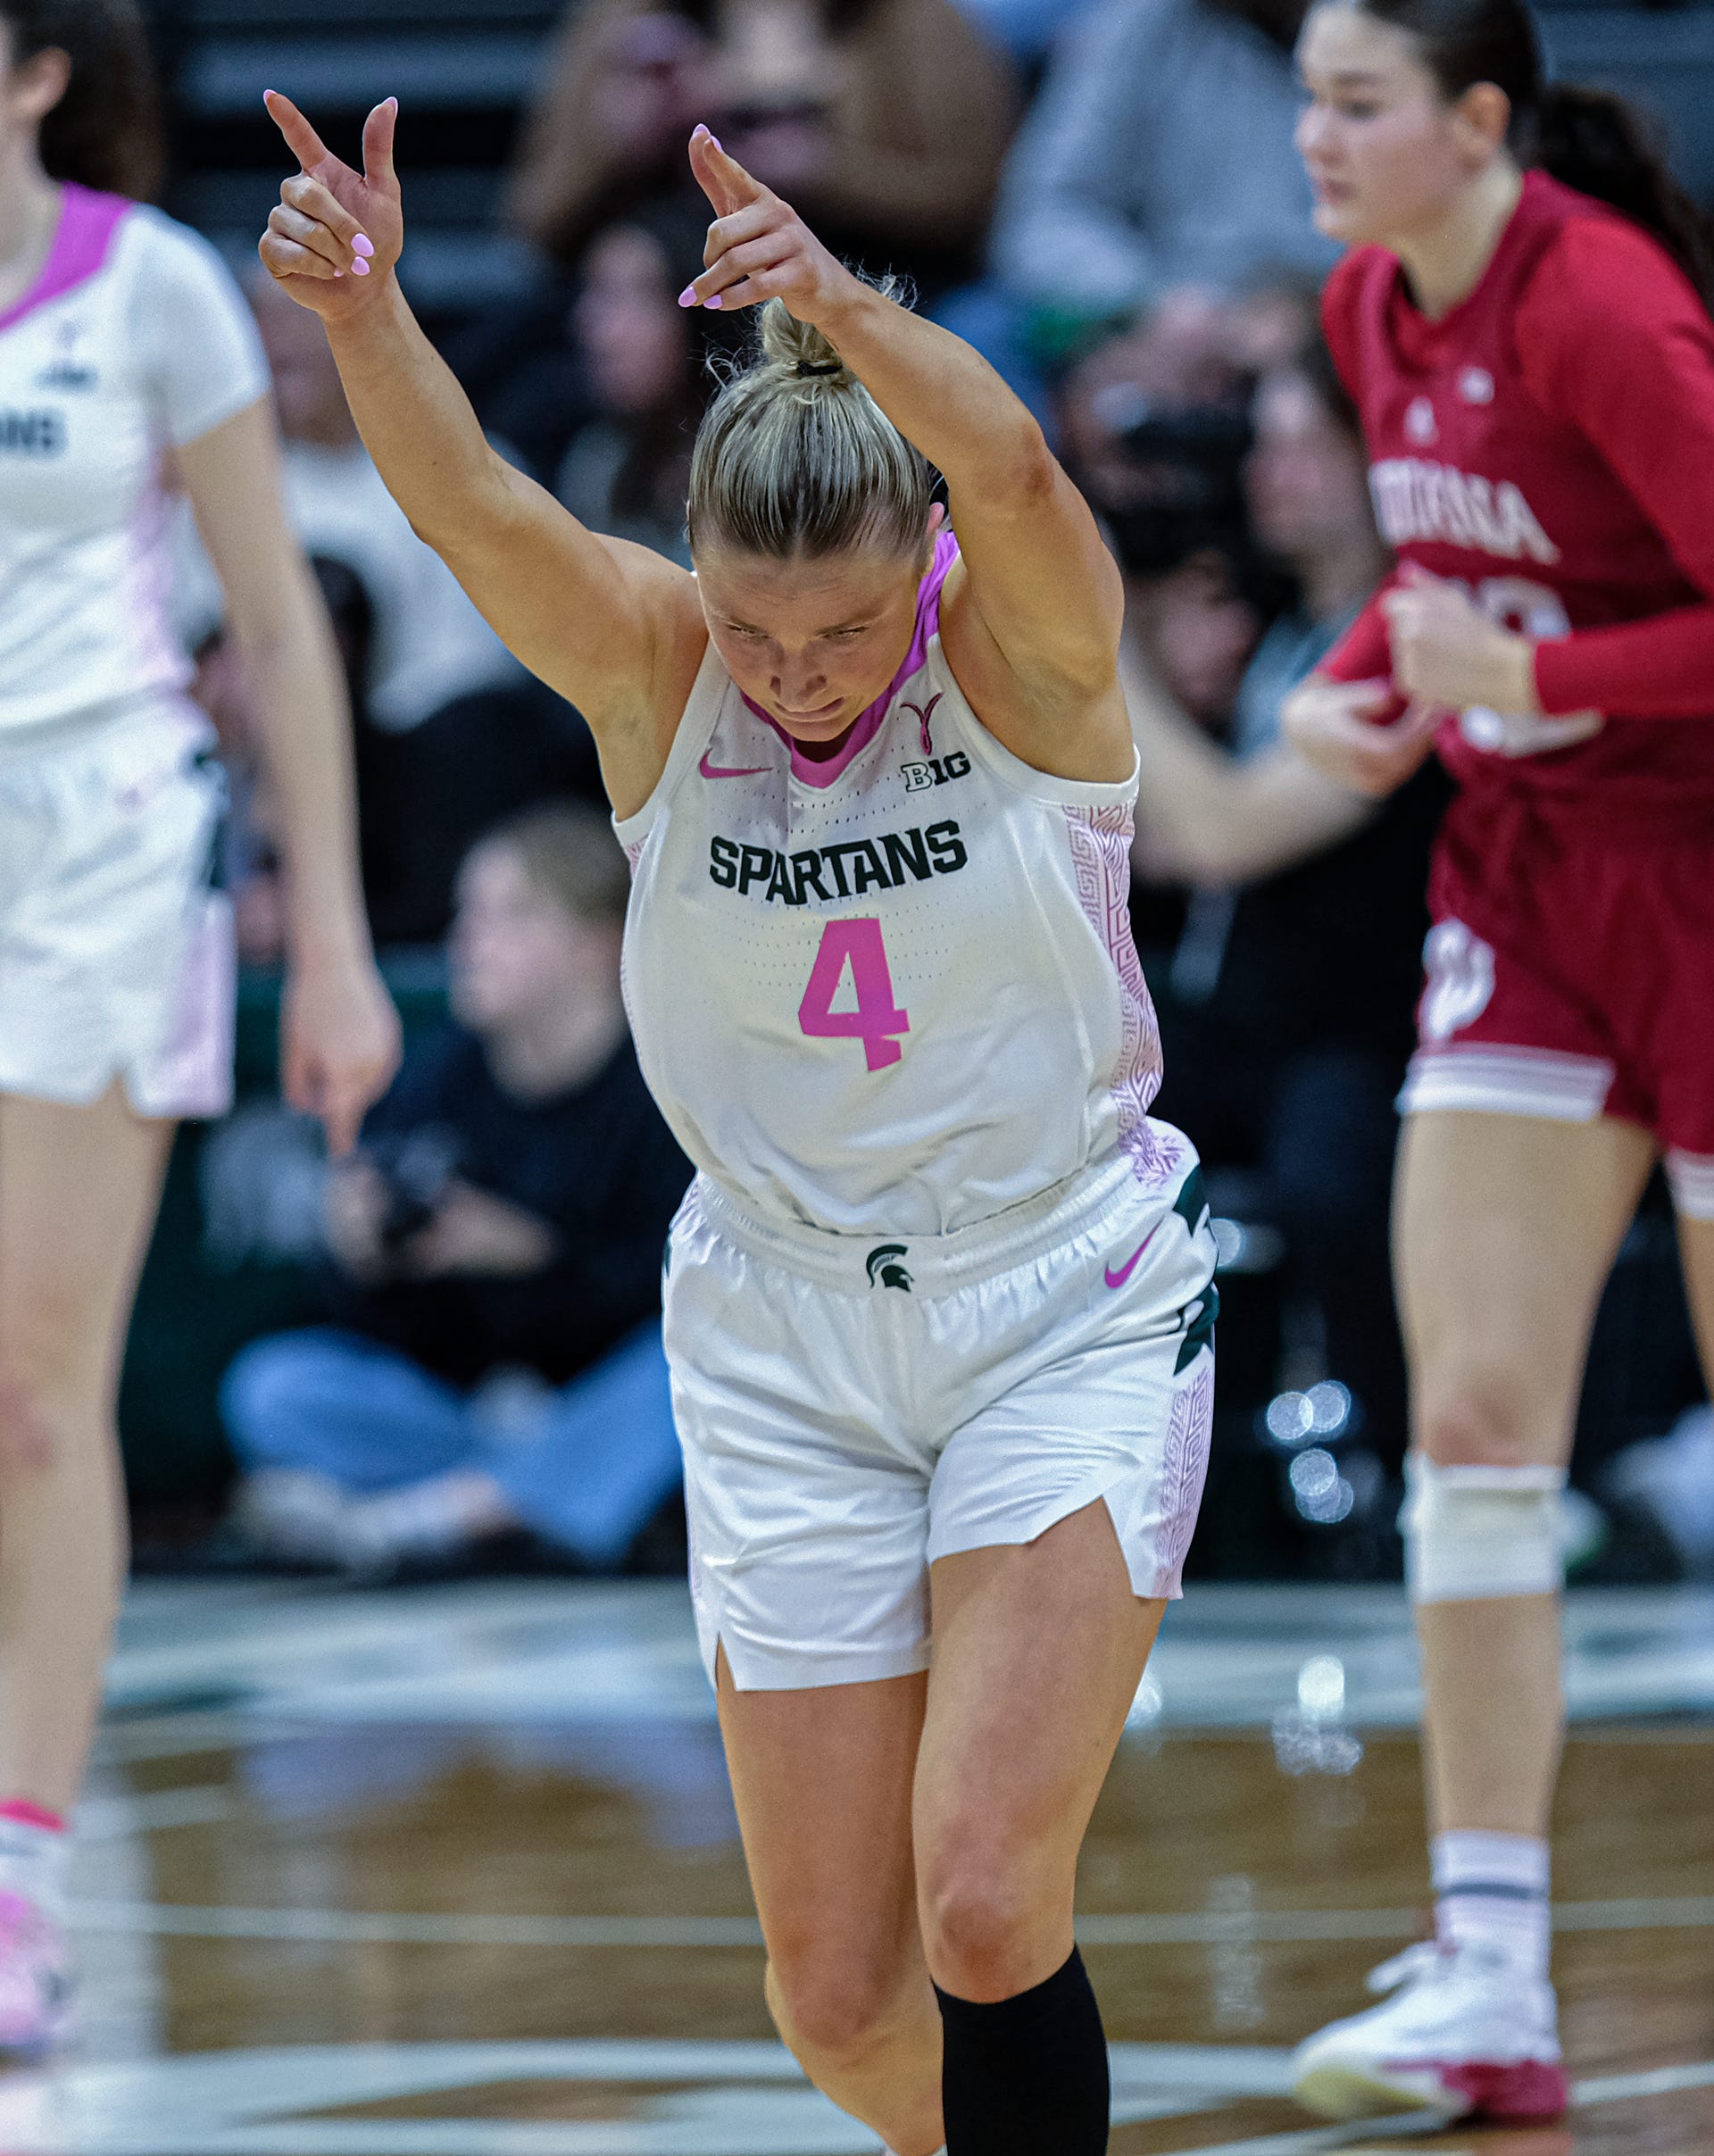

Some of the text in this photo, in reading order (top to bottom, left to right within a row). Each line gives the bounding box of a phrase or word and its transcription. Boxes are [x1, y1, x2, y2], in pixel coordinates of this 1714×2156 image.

[0, 405, 68, 459] NS
[710, 819, 968, 905] SPARTANS
[798, 917, 910, 1072] 4
